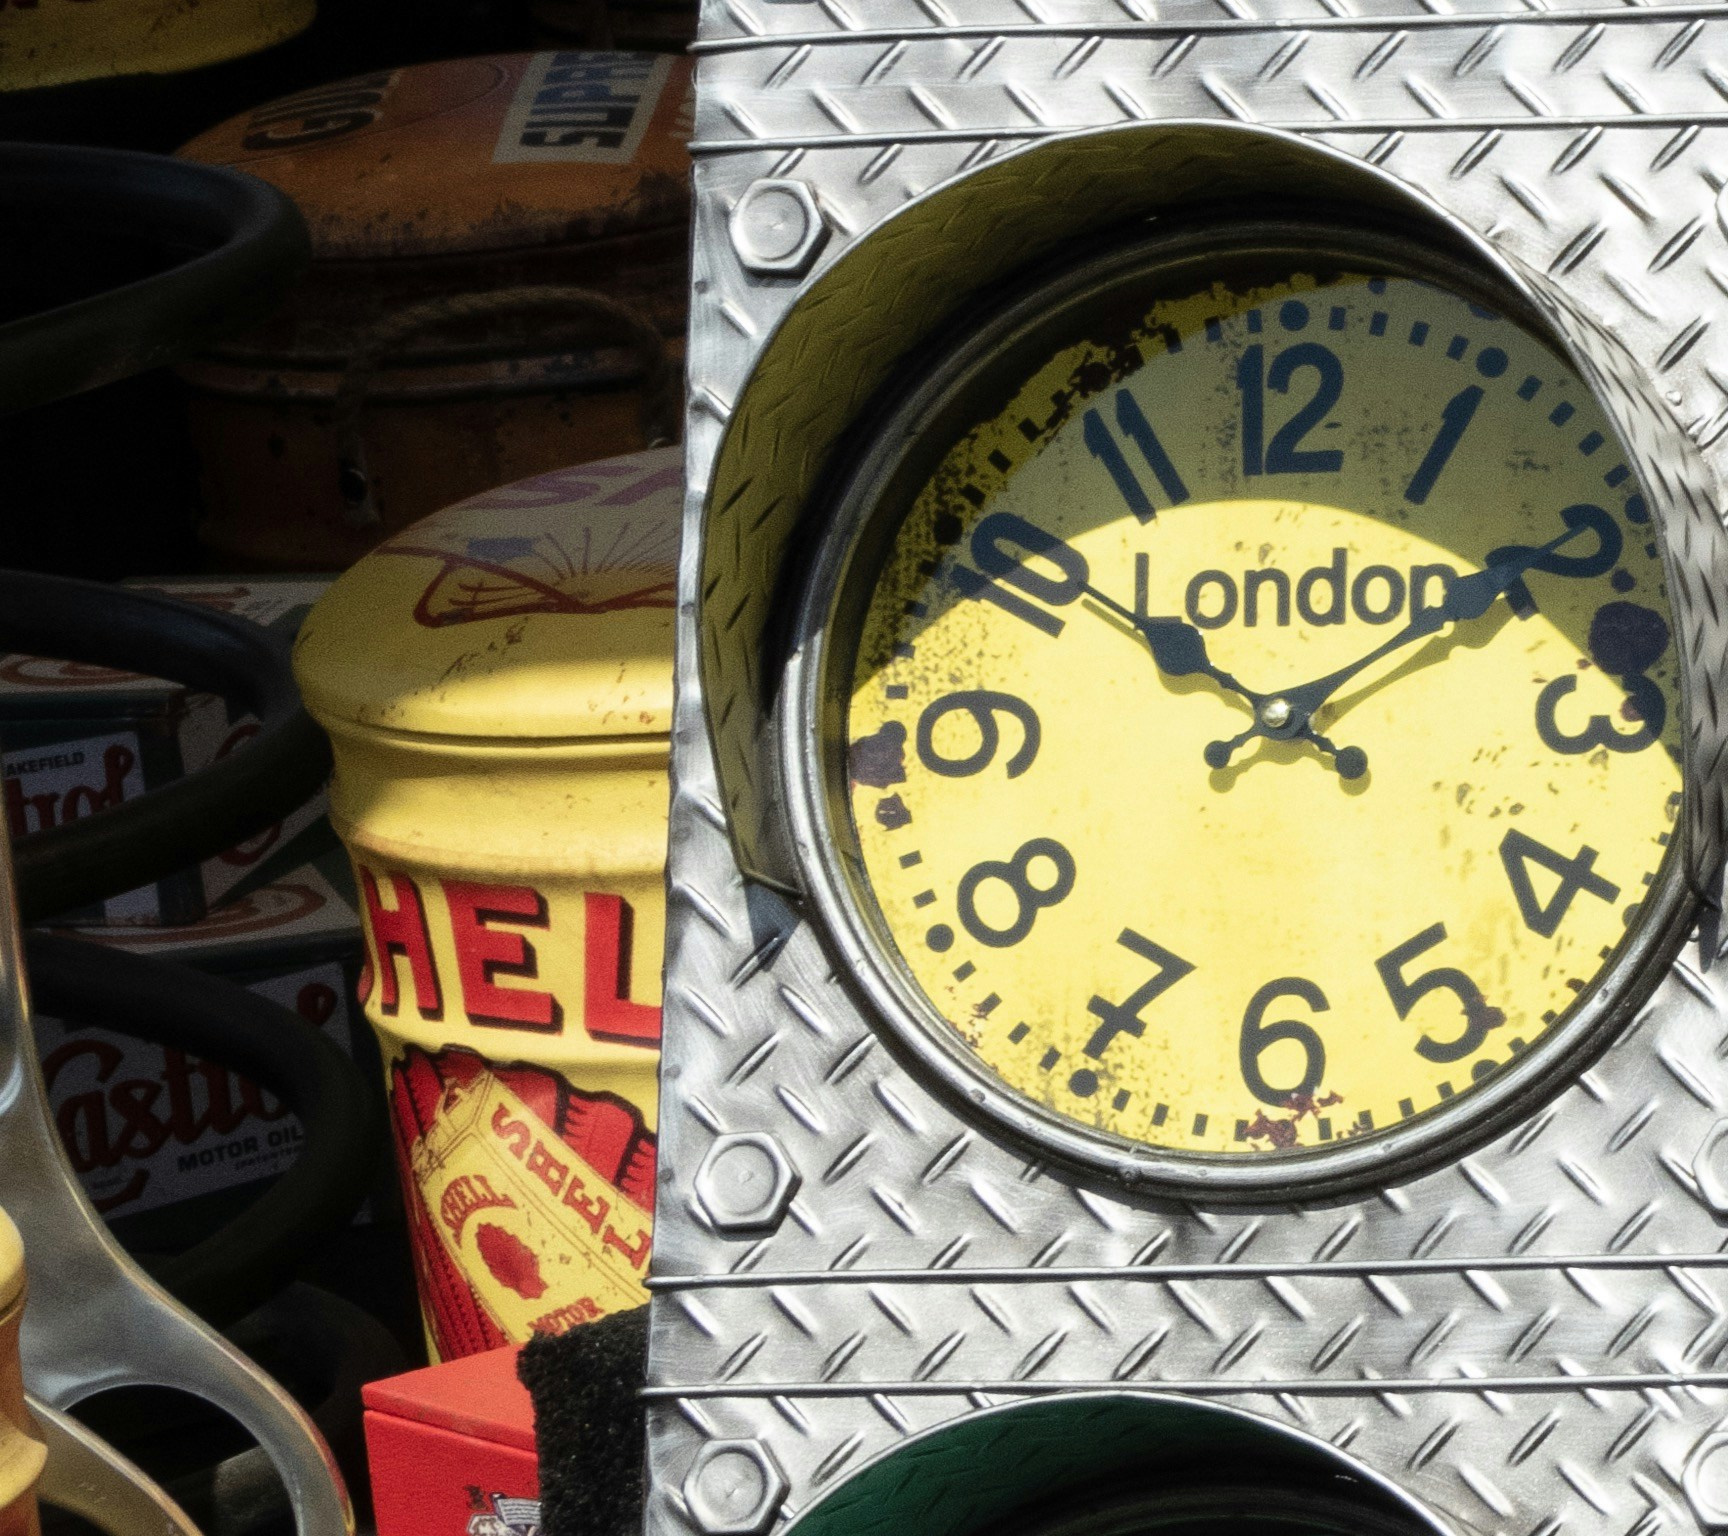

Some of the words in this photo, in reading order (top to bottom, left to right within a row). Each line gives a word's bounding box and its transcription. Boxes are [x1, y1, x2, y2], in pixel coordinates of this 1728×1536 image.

[1082, 389, 1191, 526] 11
[1237, 342, 1344, 476] 12
[1405, 383, 1484, 505] 1
[952, 510, 1090, 638] 10
[1133, 547, 1459, 629] London
[1487, 503, 1622, 620] 2
[915, 688, 1042, 779] 9
[1534, 672, 1666, 755] 3
[956, 837, 1077, 949] 8
[1498, 826, 1622, 939] 4
[1082, 927, 1197, 1060] 7
[1238, 976, 1331, 1108] 6
[1374, 921, 1492, 1063] 5
[177, 1136, 259, 1173] MOTOR
[267, 1124, 305, 1148] OIL
